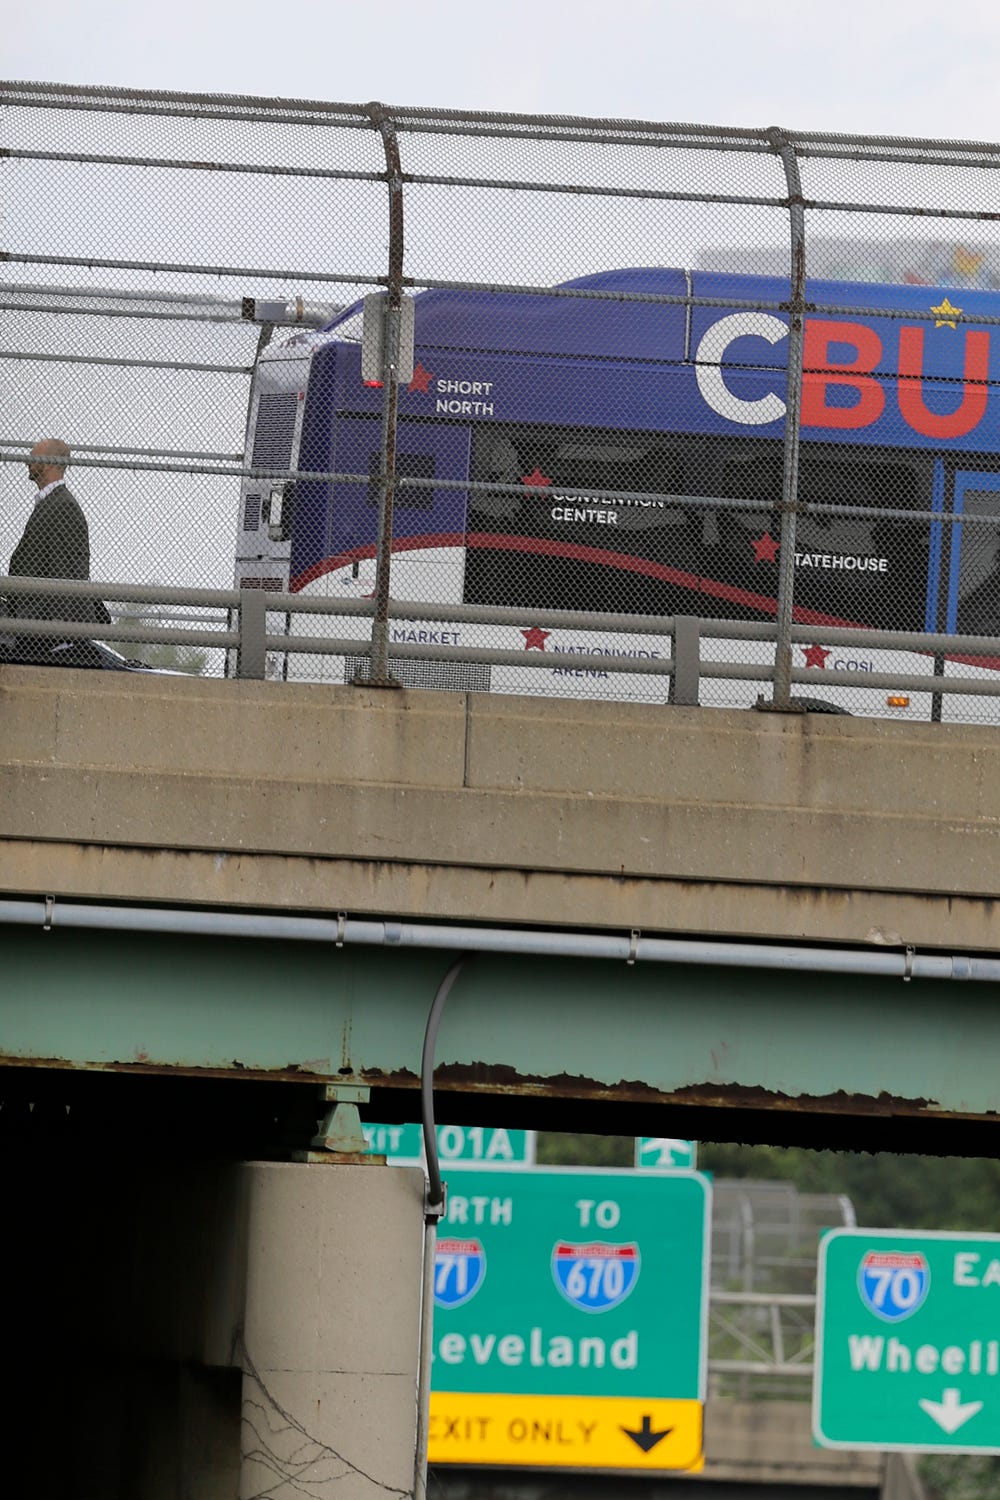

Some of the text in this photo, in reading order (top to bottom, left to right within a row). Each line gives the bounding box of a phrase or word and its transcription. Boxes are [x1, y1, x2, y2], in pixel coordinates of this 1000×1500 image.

[437, 379, 493, 395] SHORT
[436, 399, 494, 415] NORTH
[551, 507, 618, 525] CENTER
[793, 553, 888, 572] TATEHOUSE
[393, 629, 461, 645] MARKET
[834, 660, 873, 672] COSI
[364, 1126, 514, 1160] XIT 01A
[447, 1196, 620, 1229] RTH TO
[435, 1255, 625, 1300] 71 670
[867, 1268, 921, 1309] 70
[431, 1326, 639, 1370] eveland
[428, 1415, 598, 1445] EXIT ONLY
